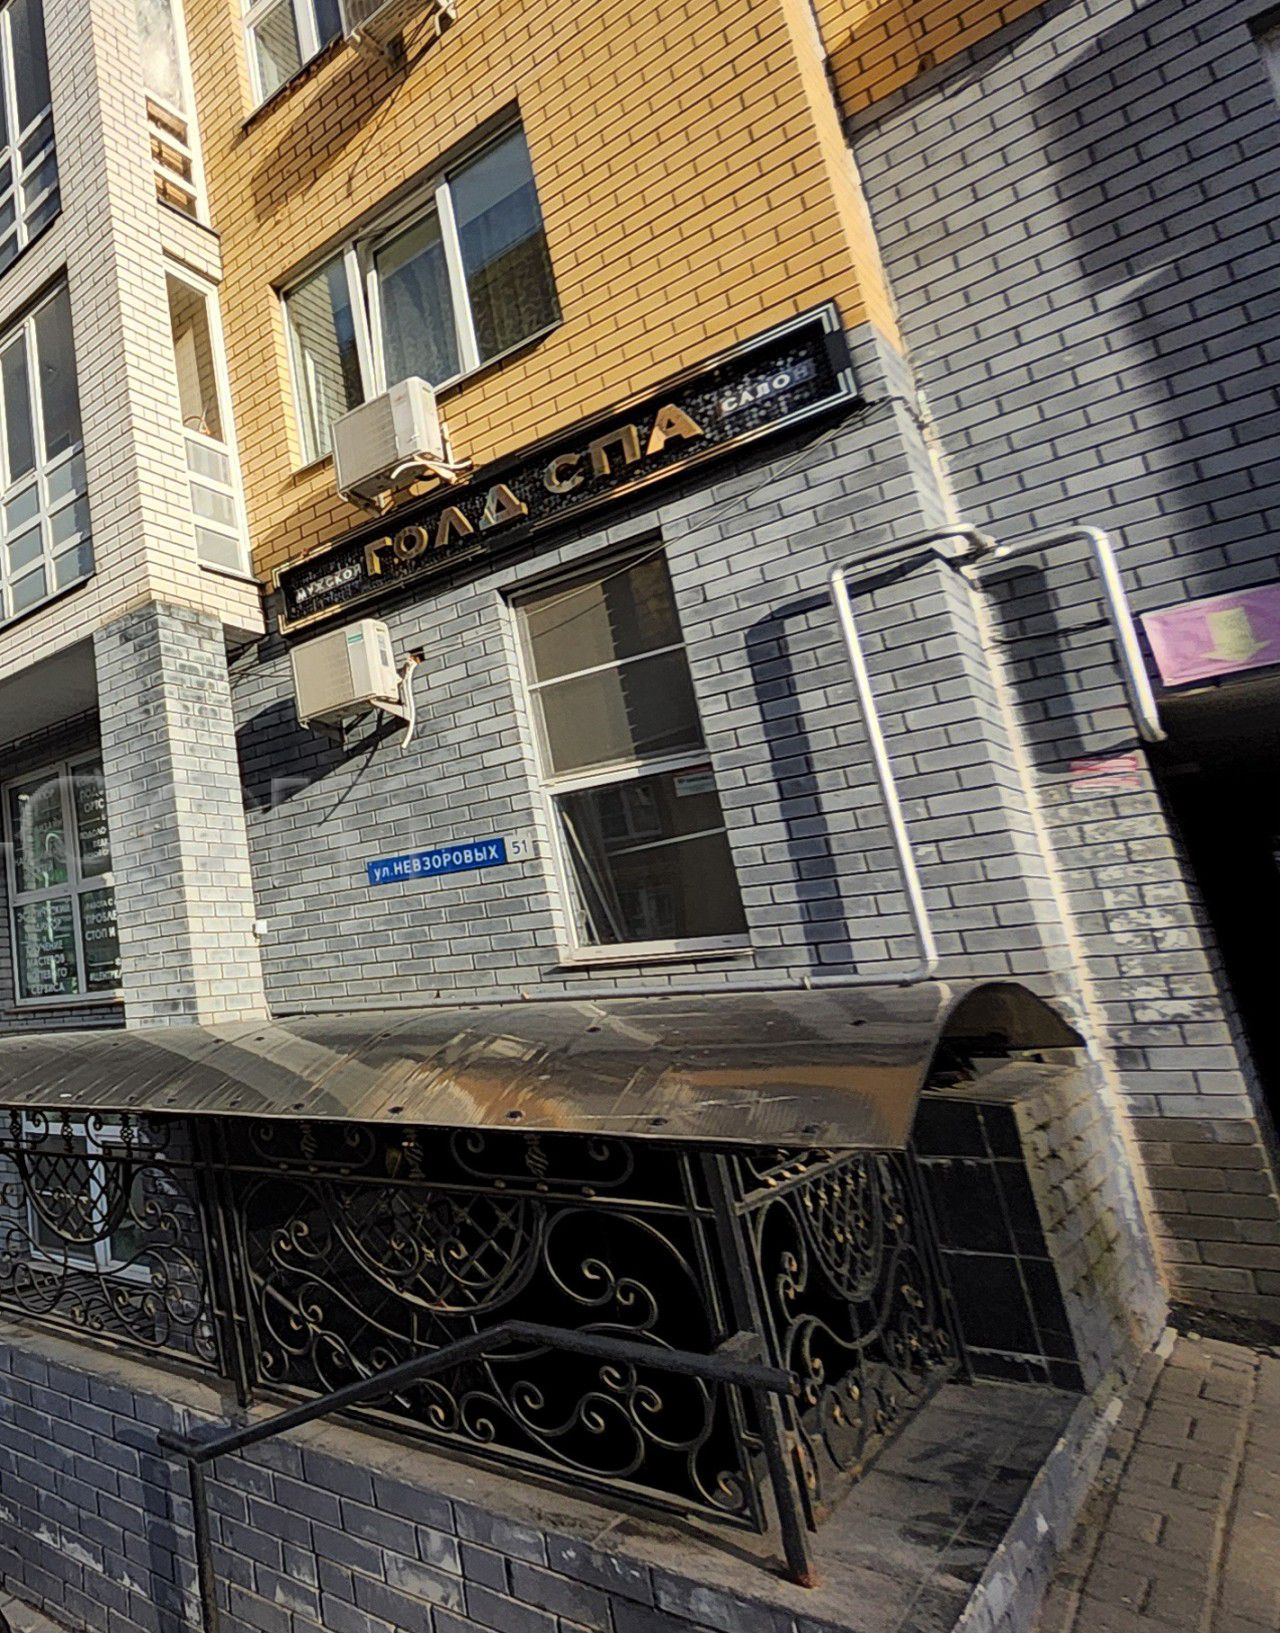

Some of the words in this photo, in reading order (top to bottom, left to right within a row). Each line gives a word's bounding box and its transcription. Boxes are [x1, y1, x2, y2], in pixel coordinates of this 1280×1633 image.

[364, 484, 528, 576] ГОЛД
[543, 403, 704, 493] СПА
[511, 840, 529, 855] 51
